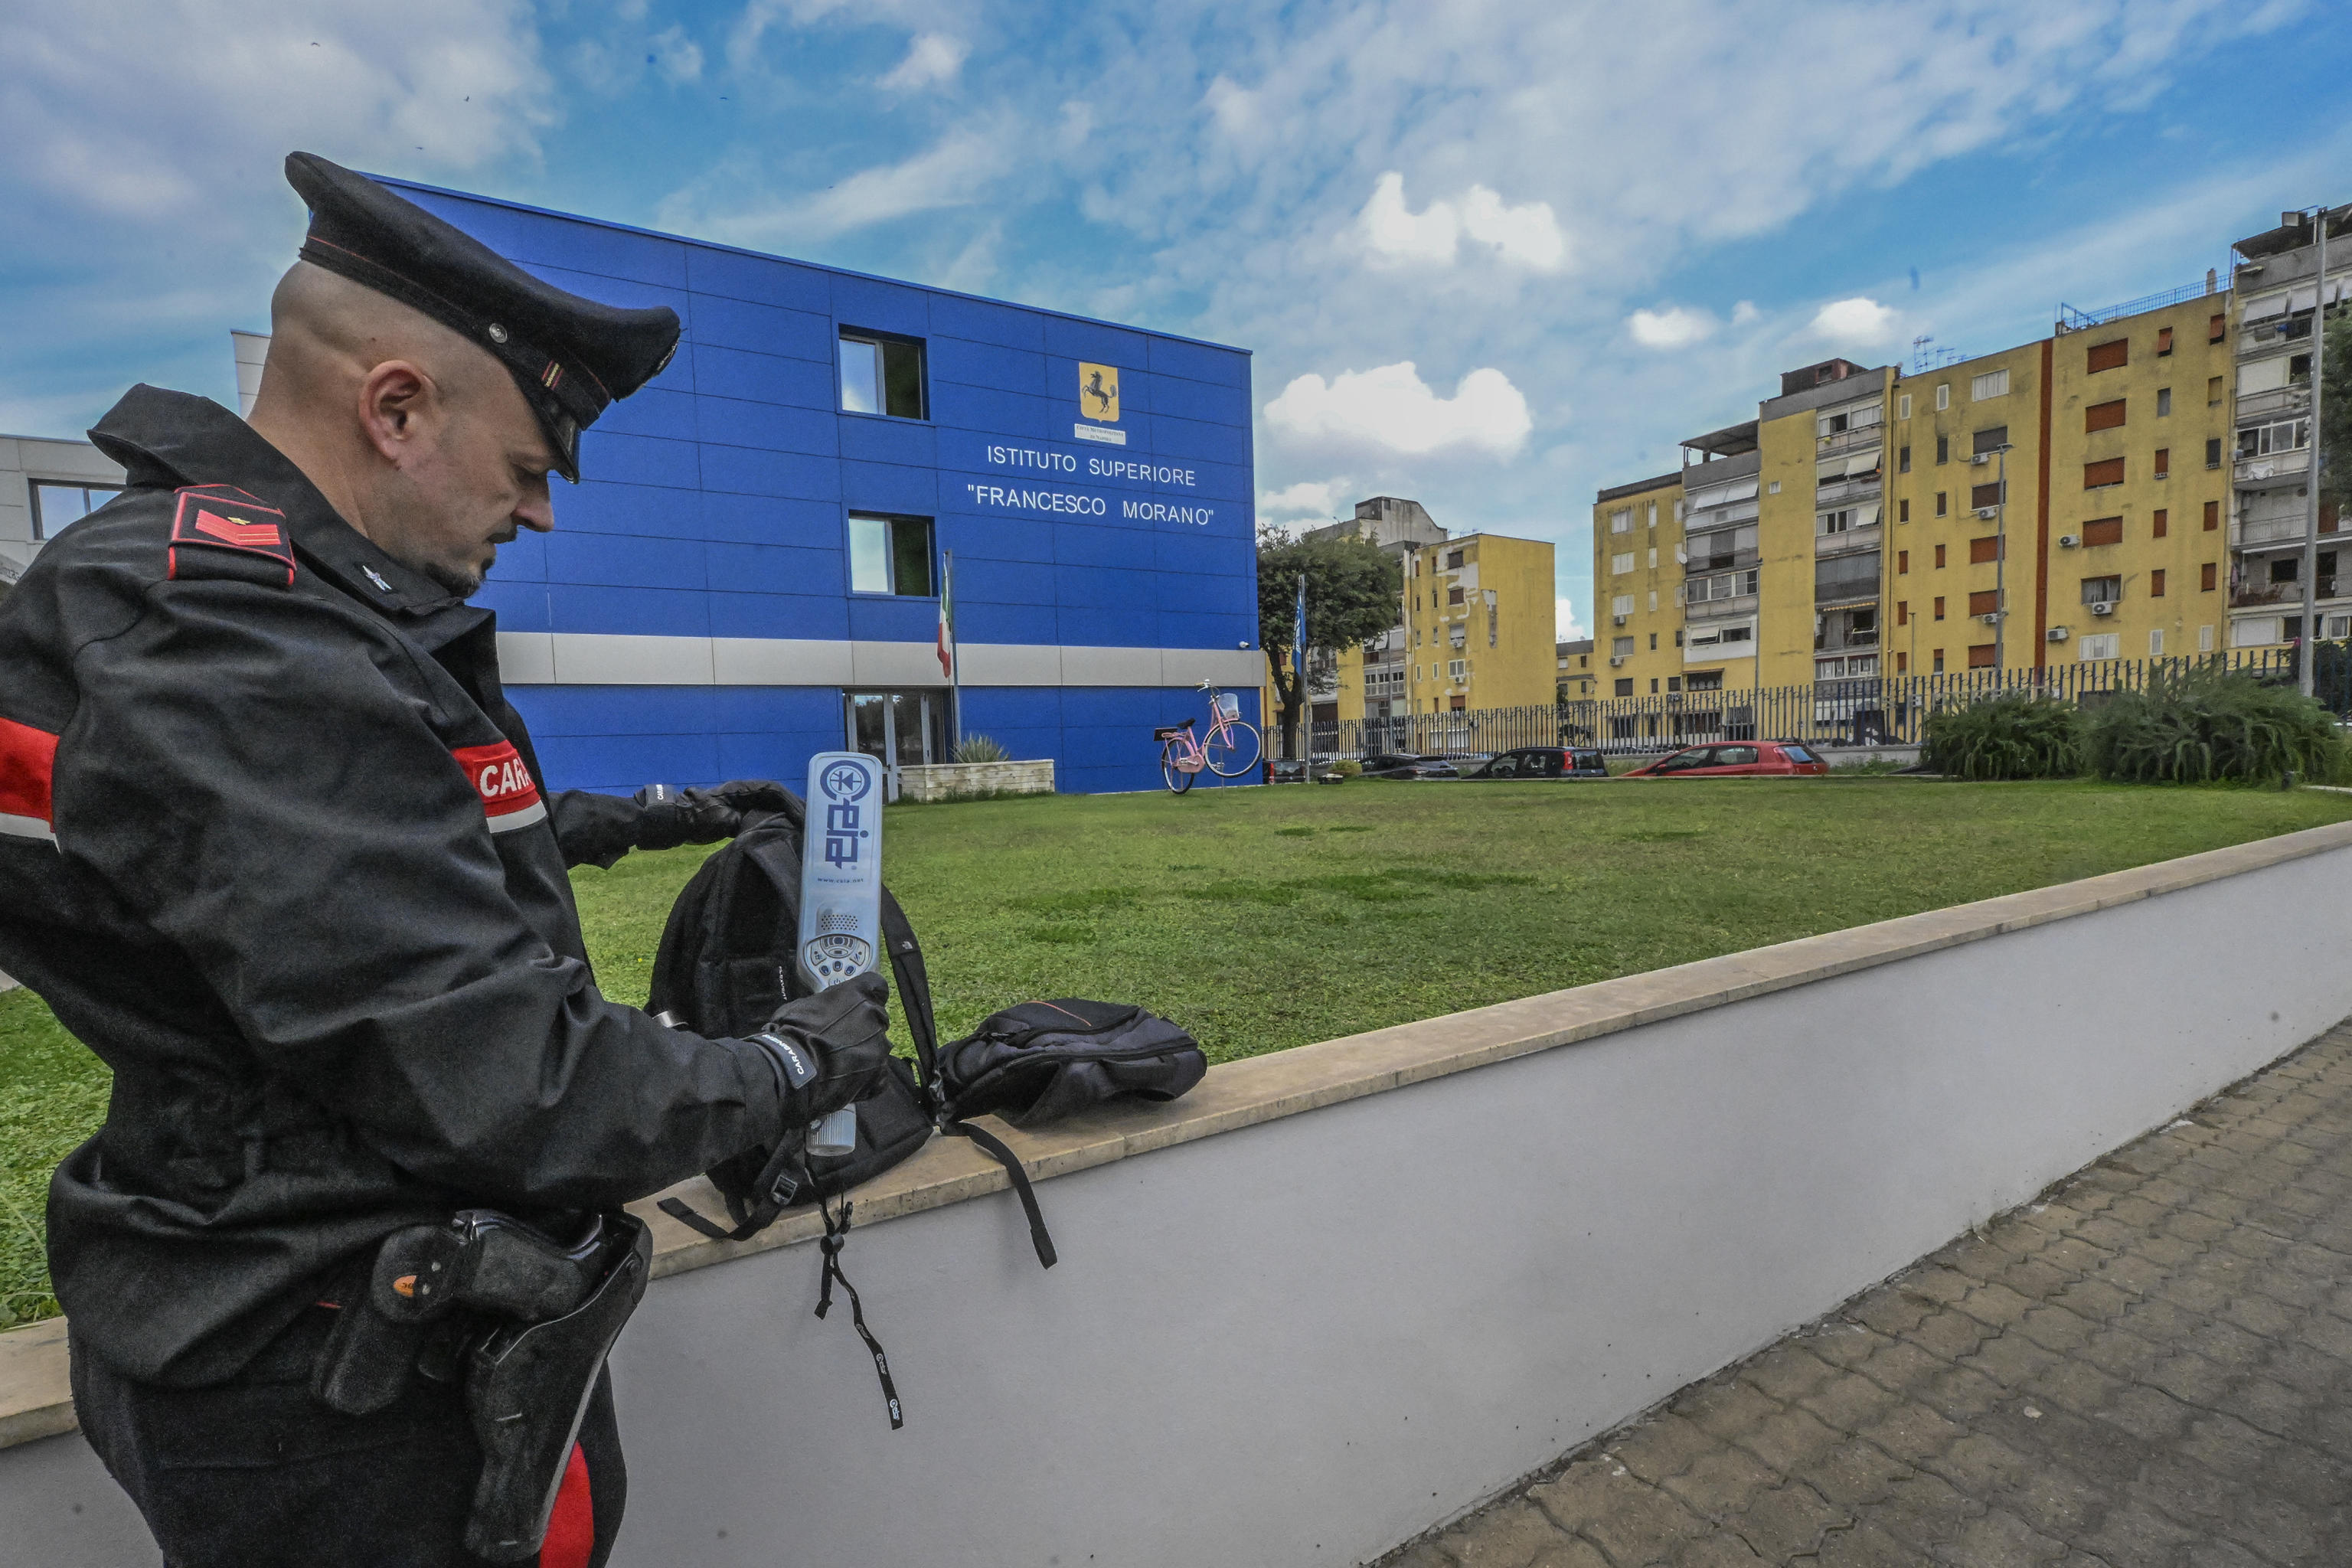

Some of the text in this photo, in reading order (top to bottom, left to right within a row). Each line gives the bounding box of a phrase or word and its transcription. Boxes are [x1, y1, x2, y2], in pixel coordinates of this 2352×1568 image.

[988, 446, 1196, 486] ISTITUTO SUPERIORE
[968, 484, 1214, 525] "FRANCESCO MORANO"
